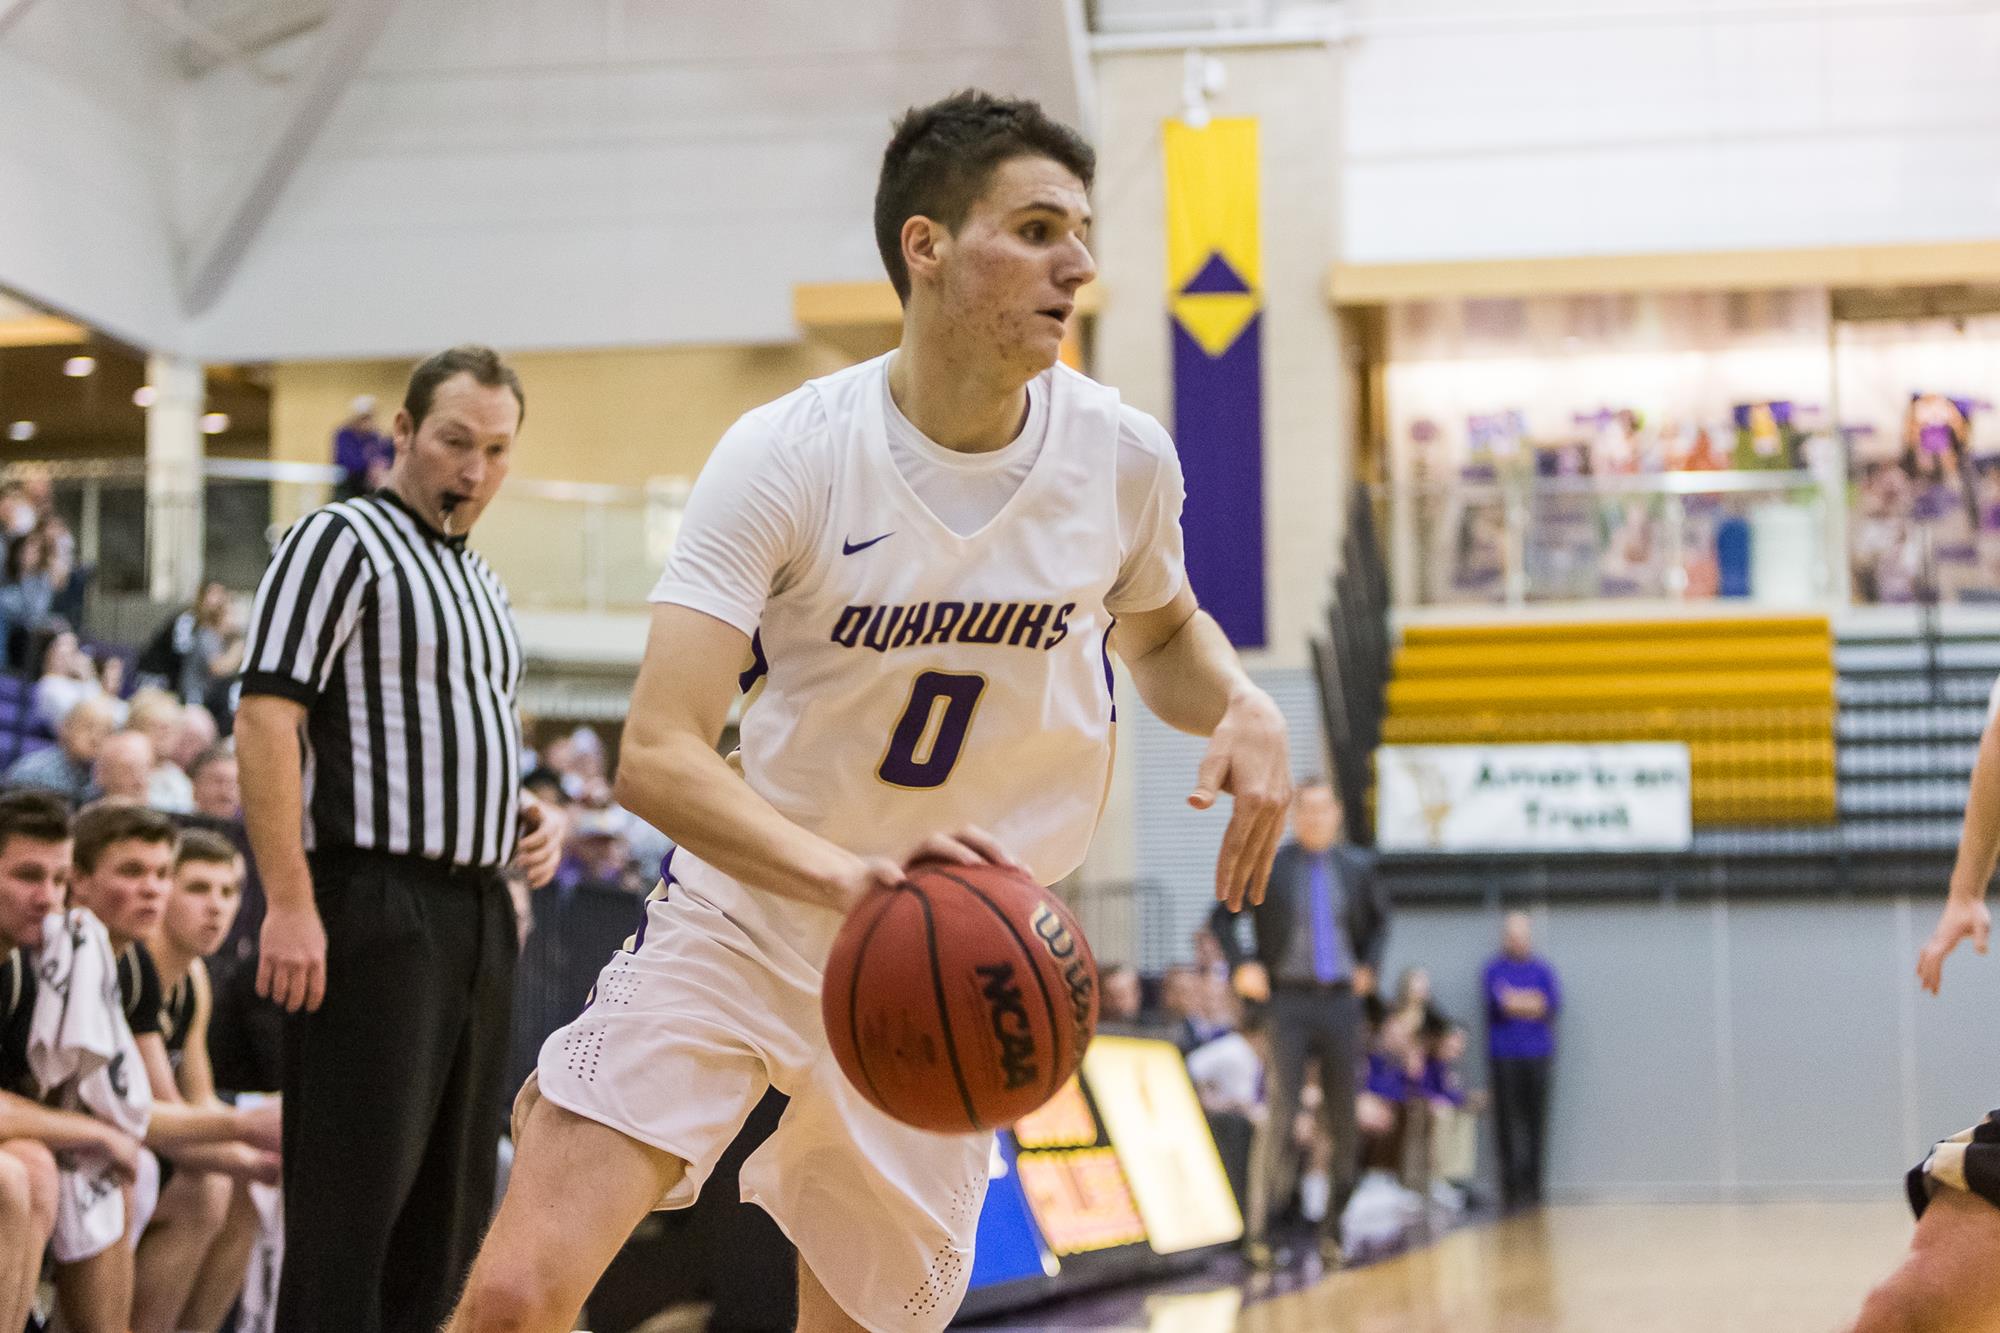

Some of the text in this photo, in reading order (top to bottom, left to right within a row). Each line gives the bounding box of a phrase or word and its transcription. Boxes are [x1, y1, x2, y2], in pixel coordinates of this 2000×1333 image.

[831, 601, 1077, 652] DUHAWKS
[874, 667, 990, 791] 0
[975, 962, 1038, 1090] NCAA
